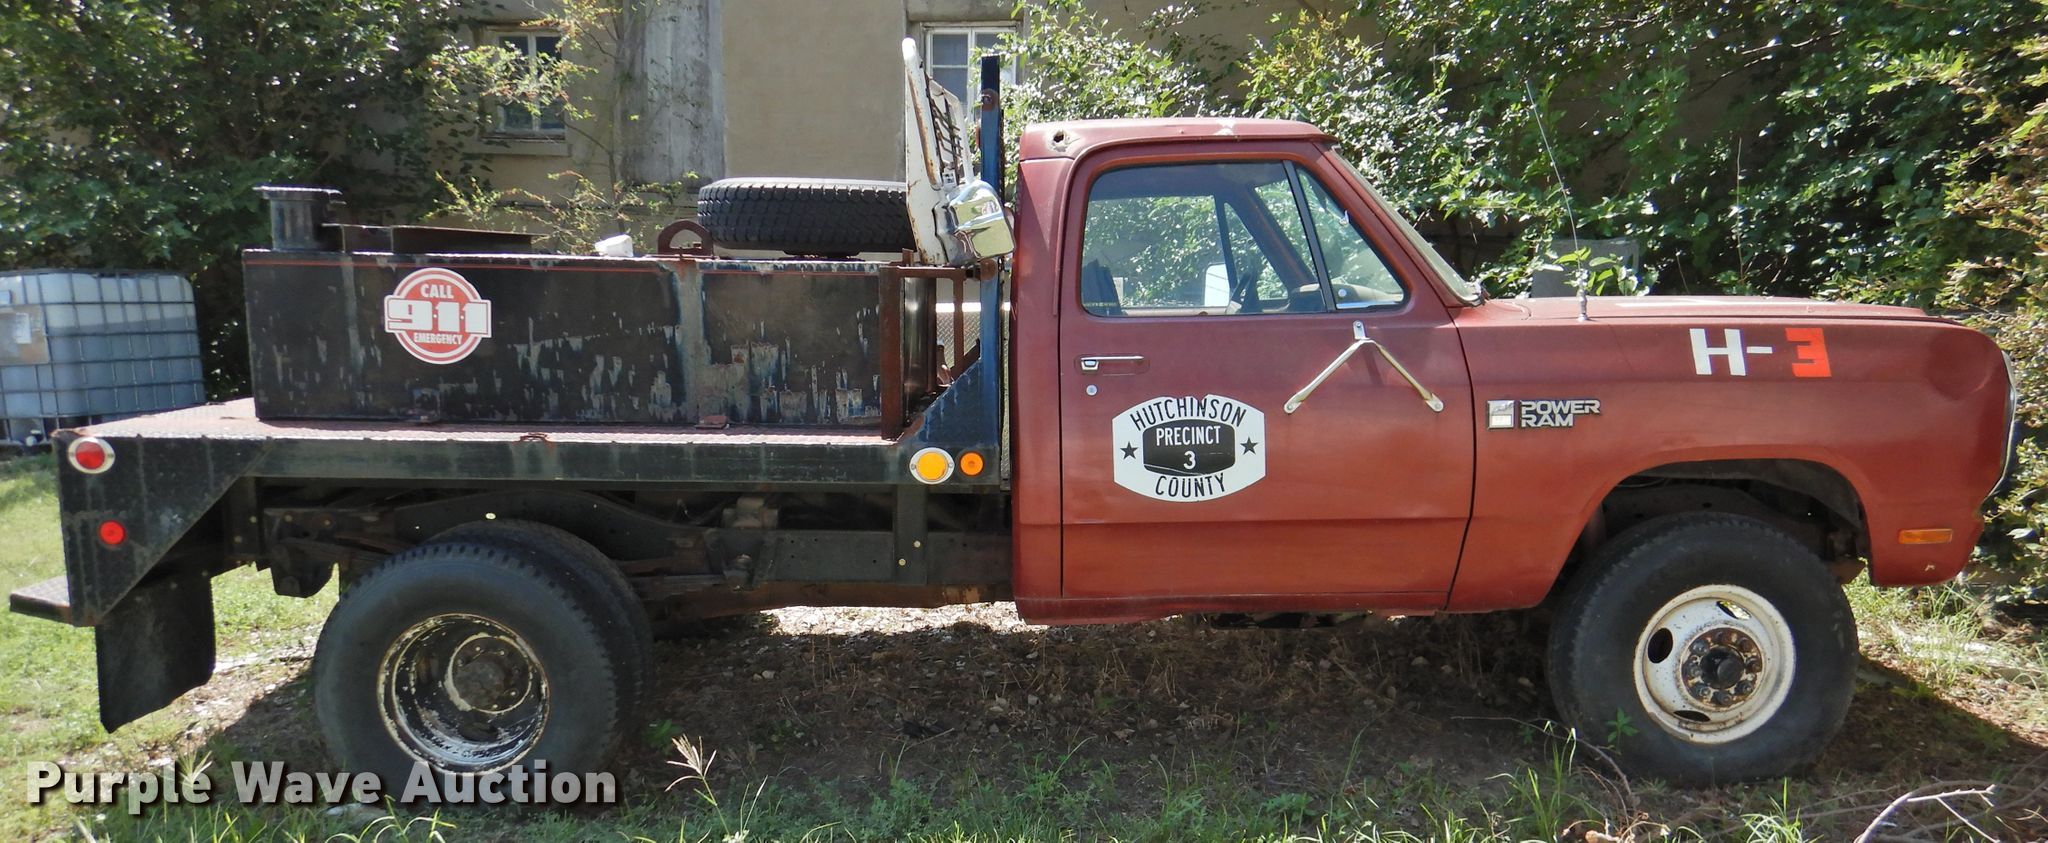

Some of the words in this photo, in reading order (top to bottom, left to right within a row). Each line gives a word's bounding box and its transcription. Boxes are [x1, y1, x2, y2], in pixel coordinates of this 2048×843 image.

[420, 283, 454, 299] CALL
[413, 332, 463, 345] EMERGENCY
[1130, 397, 1247, 432] HUTCHINSON
[1520, 399, 1600, 414] POWER
[1521, 413, 1574, 427] RAM
[1156, 425, 1221, 447] PRECINCT
[1183, 450, 1196, 470] 3
[1155, 472, 1226, 498] COUNTY
